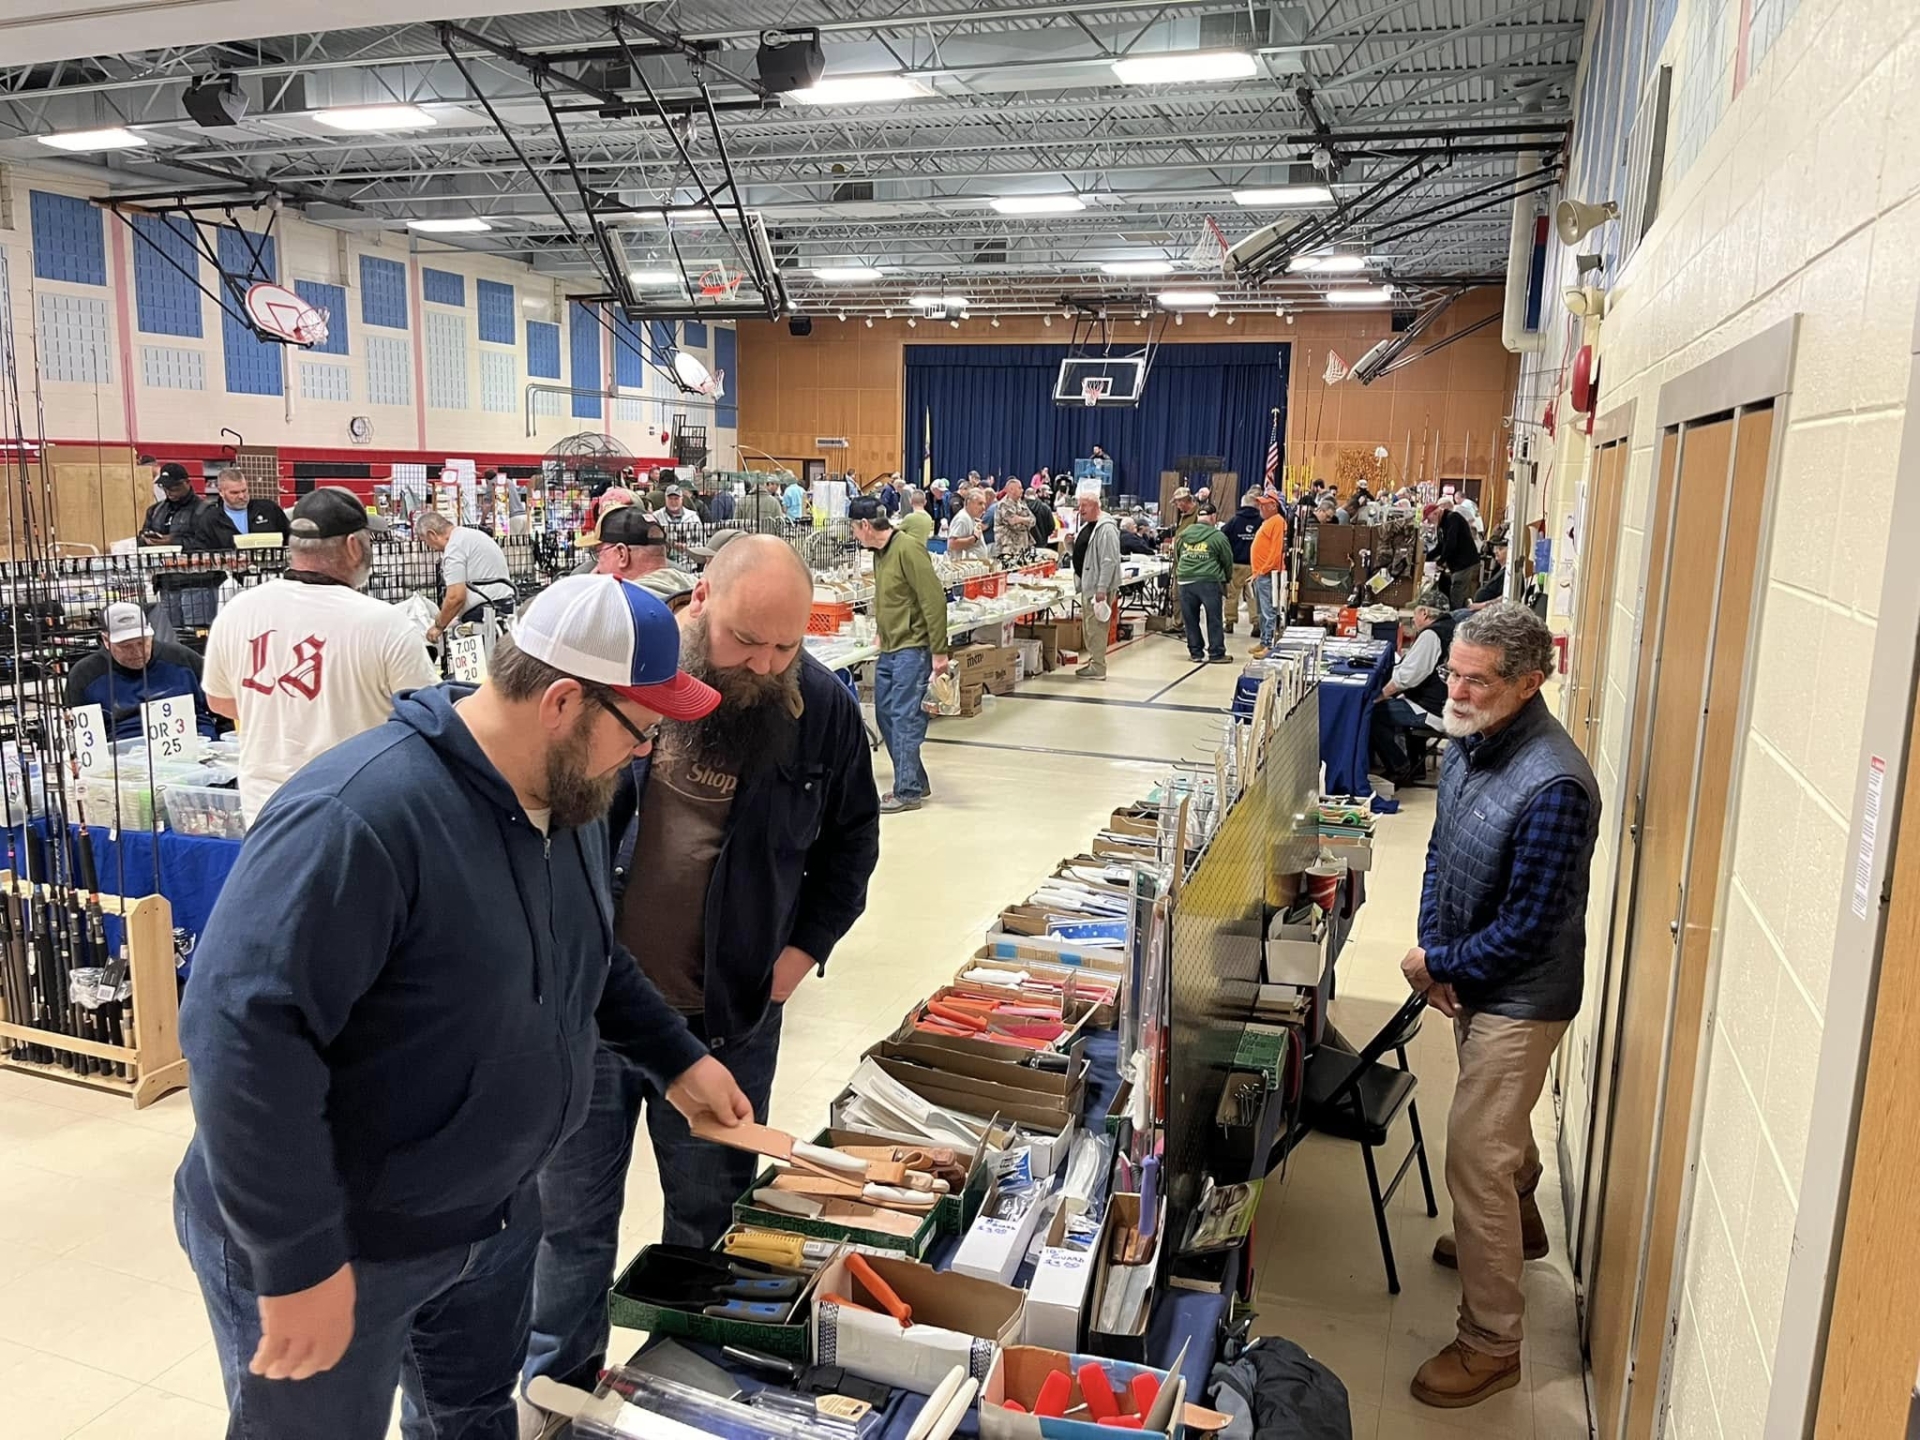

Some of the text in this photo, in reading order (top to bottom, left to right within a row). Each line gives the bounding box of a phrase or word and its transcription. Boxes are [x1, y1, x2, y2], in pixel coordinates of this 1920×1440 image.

[456, 638, 477, 654] 7.00
[455, 652, 478, 669] OR 3
[464, 666, 478, 681] 20
[162, 702, 172, 718] 9
[149, 718, 185, 741] OR 3
[83, 730, 94, 747] 3
[162, 737, 182, 757] 25
[686, 763, 738, 794] Shop
